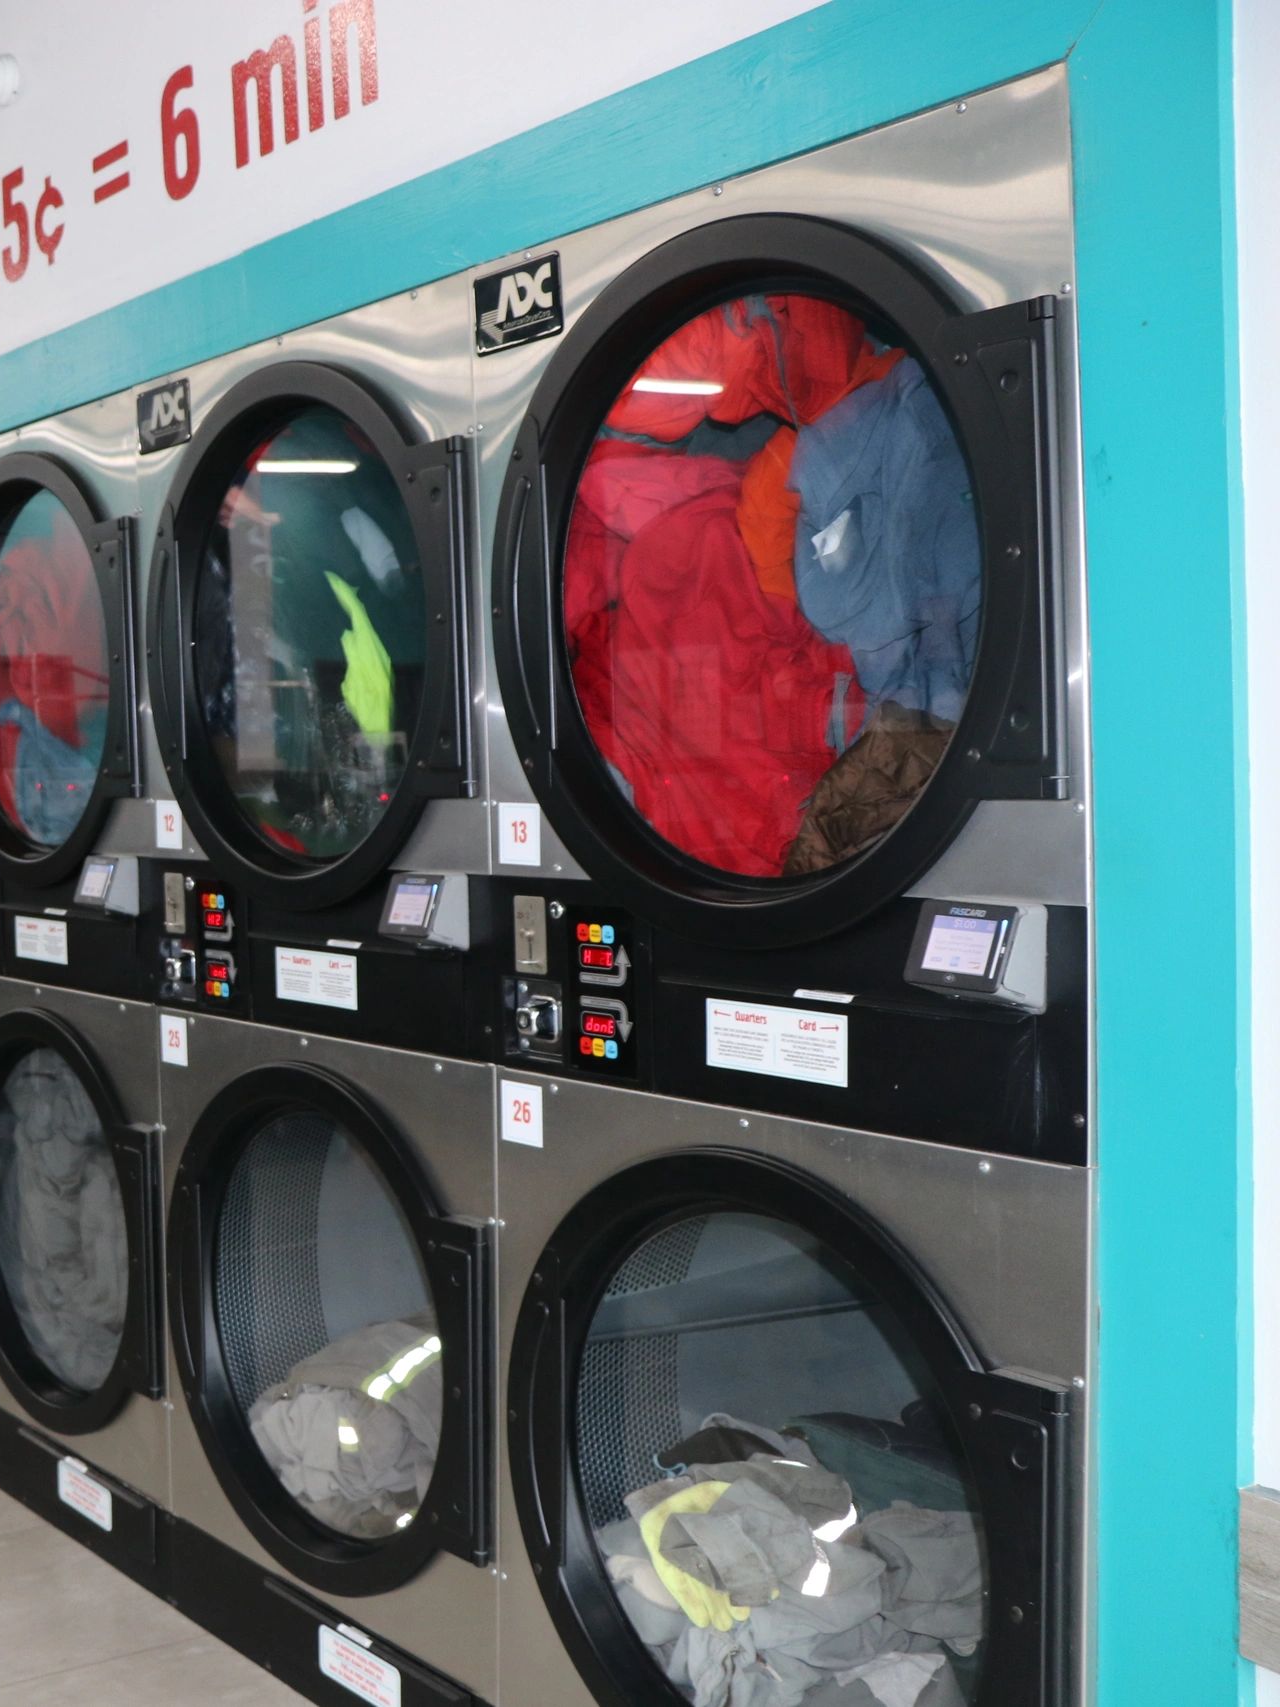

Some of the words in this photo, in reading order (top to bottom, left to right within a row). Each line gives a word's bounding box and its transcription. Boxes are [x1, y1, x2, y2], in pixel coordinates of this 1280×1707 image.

[160, 64, 201, 201] 6
[231, 0, 379, 169] min
[496, 261, 554, 323] ADC
[151, 385, 186, 430] ADC
[164, 814, 175, 832] 12
[511, 821, 527, 844] 13
[734, 1010, 767, 1025] Quarters
[798, 1018, 817, 1032] Card
[168, 1028, 180, 1048] 25
[513, 1099, 531, 1124] 26
